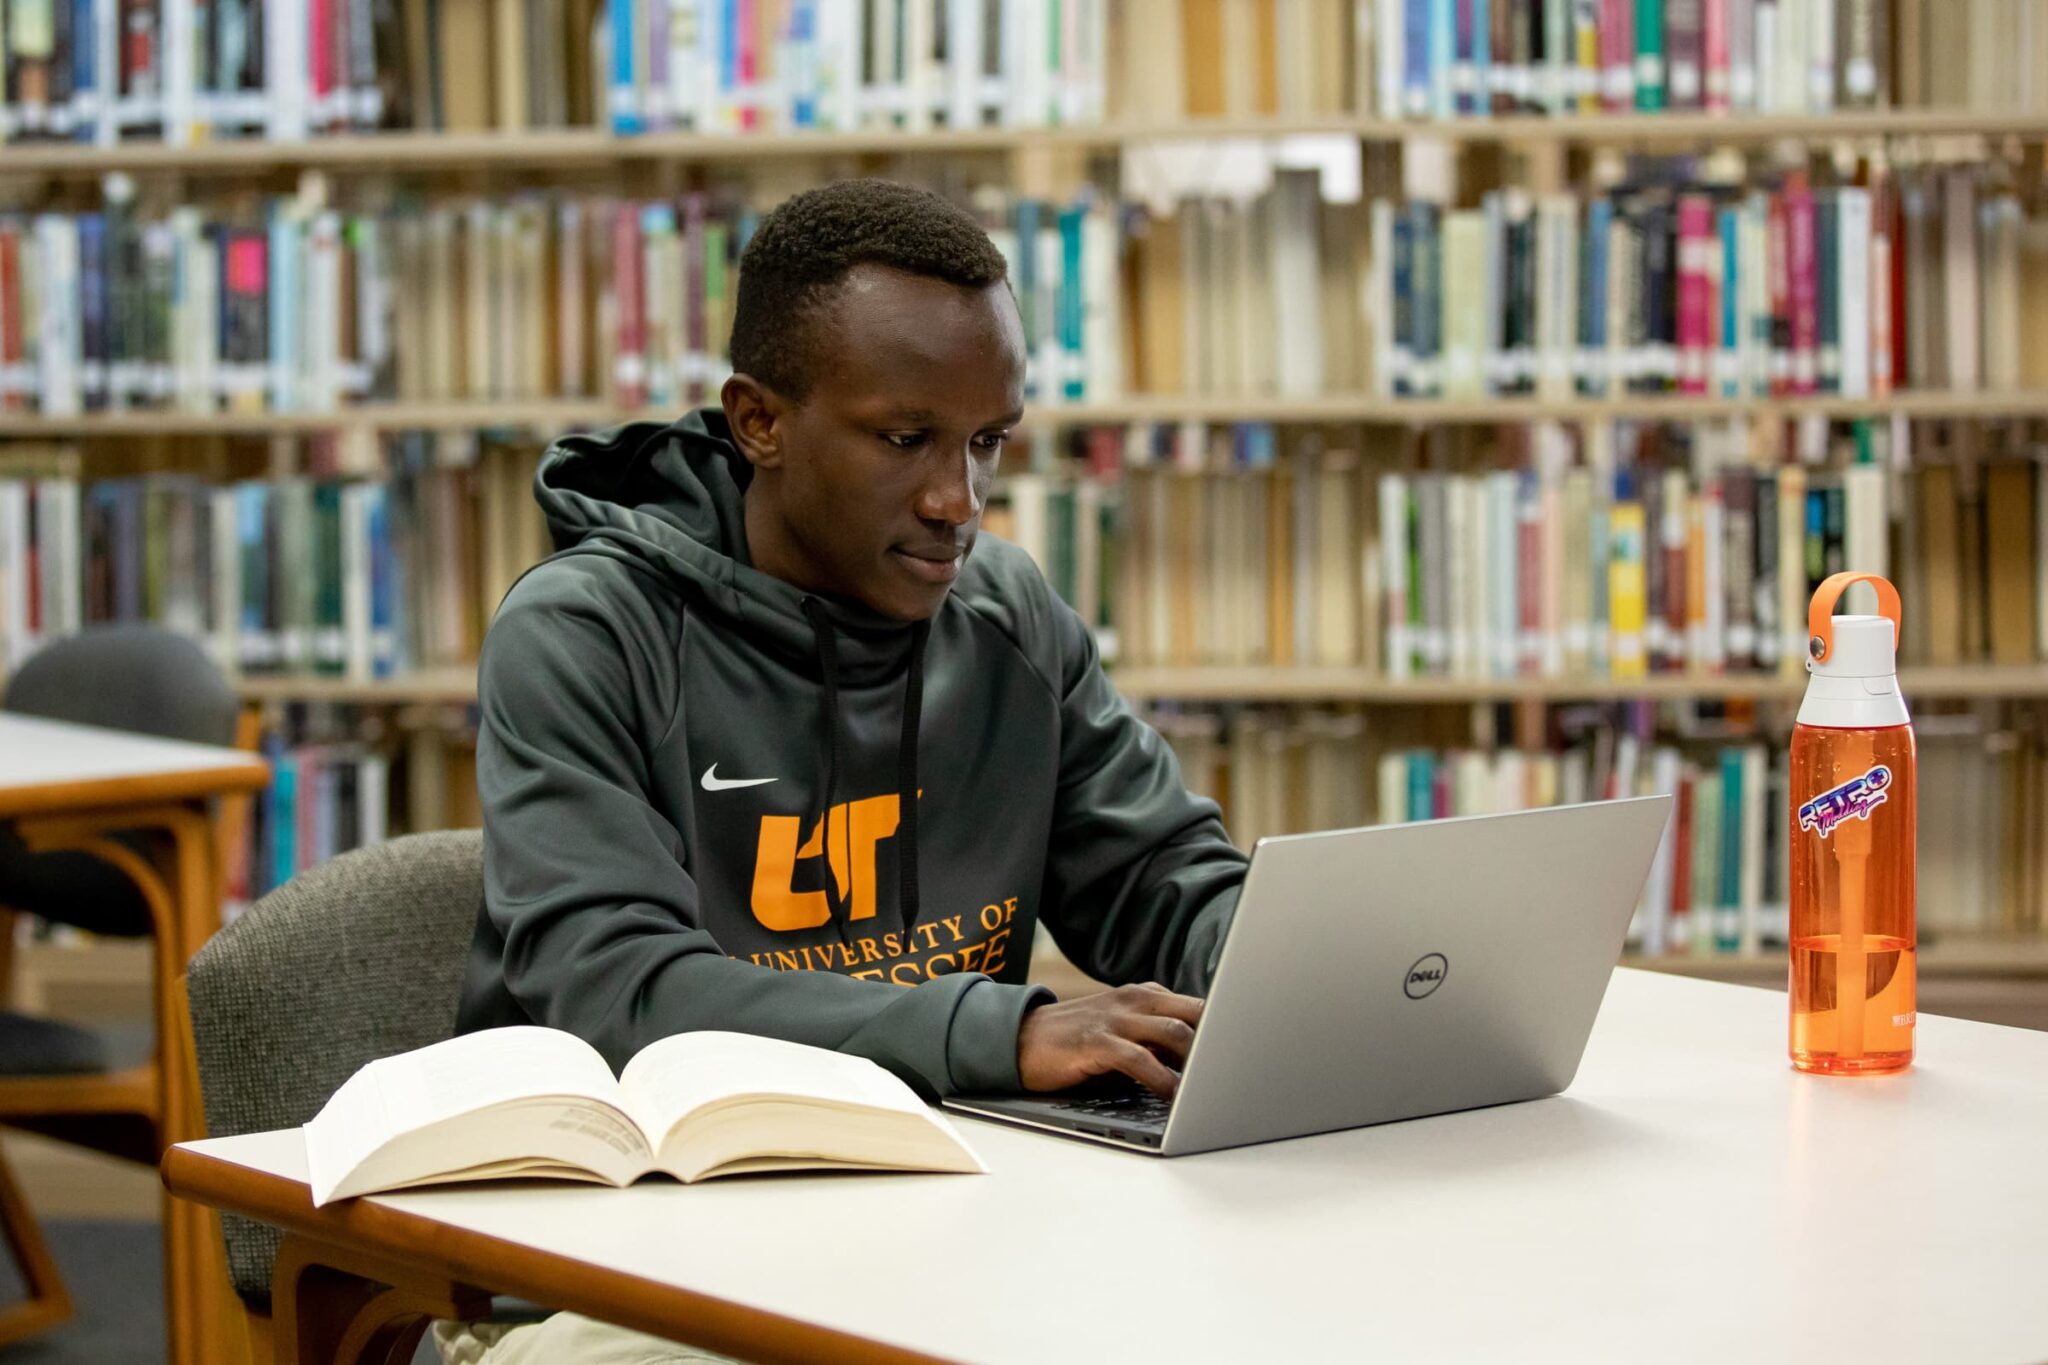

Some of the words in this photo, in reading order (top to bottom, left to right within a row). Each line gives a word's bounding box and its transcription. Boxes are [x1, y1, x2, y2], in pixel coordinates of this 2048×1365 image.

[1800, 768, 1889, 828] RETRO
[980, 896, 1018, 931] OF
[1409, 969, 1440, 983] DELL
